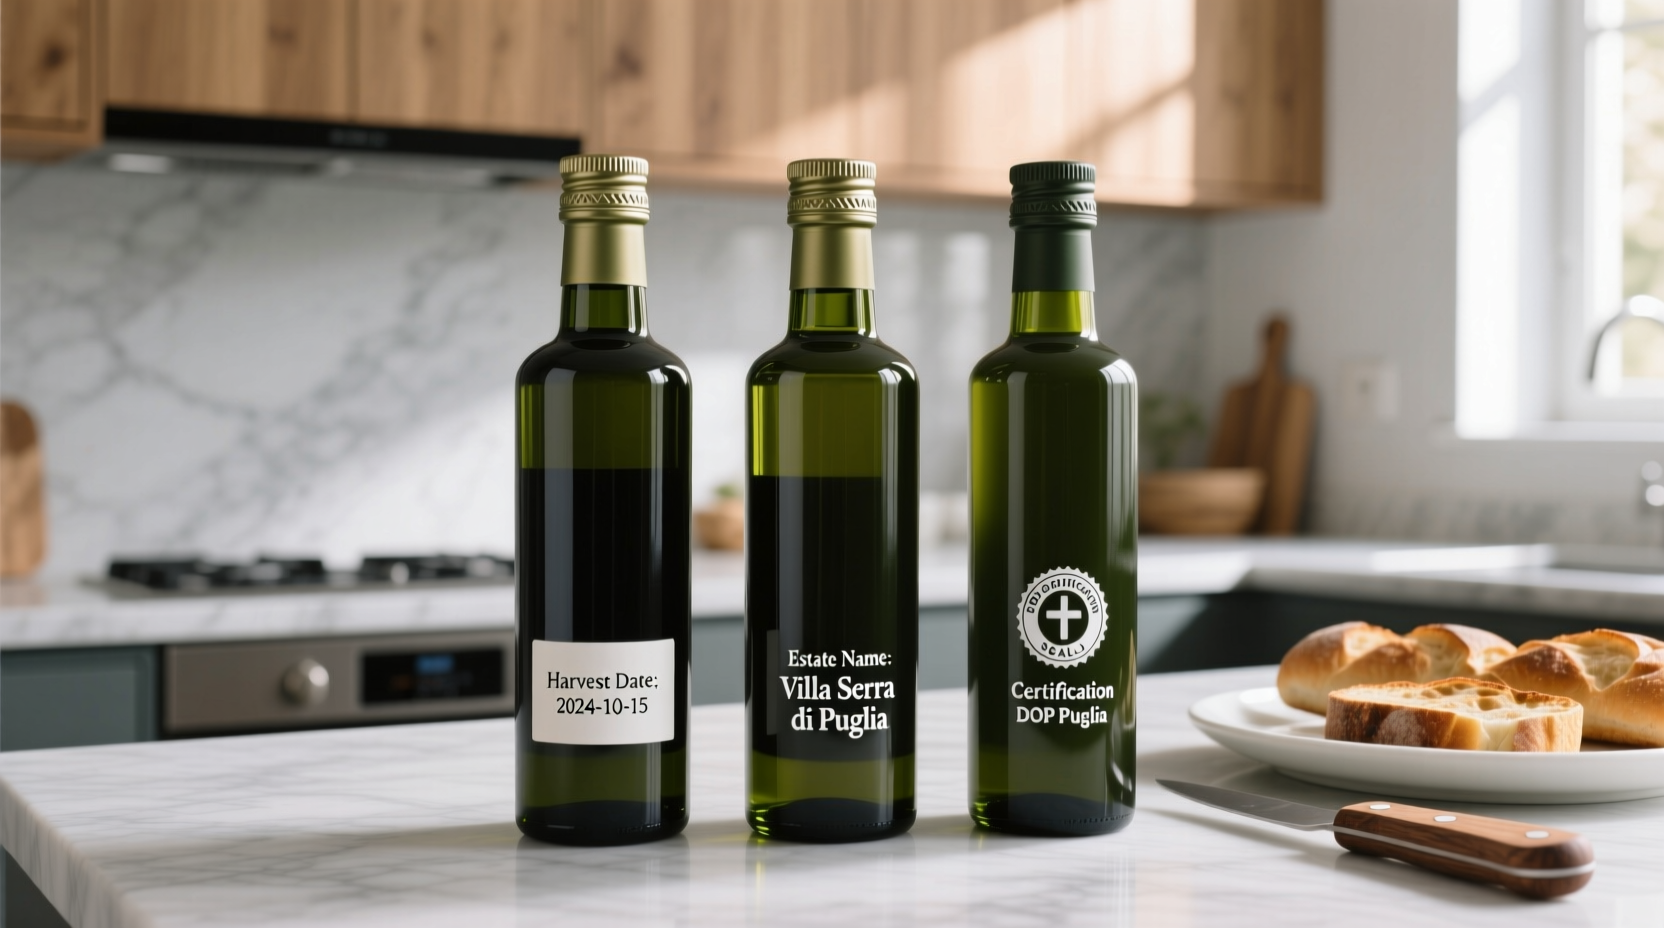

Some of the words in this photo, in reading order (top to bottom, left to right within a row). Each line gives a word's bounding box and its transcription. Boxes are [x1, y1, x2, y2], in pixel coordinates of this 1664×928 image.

[788, 650, 837, 668] Estate
[841, 649, 892, 667] Name:
[547, 671, 610, 689] Harvest
[780, 676, 832, 700] Villa
[837, 675, 896, 700] Serra
[1011, 681, 1114, 700] Certification
[556, 697, 648, 715] 2024-10-15
[790, 706, 814, 731] di
[818, 706, 890, 739] Puglia
[1016, 706, 1056, 724] DOP
[1058, 705, 1108, 729] Puglia
